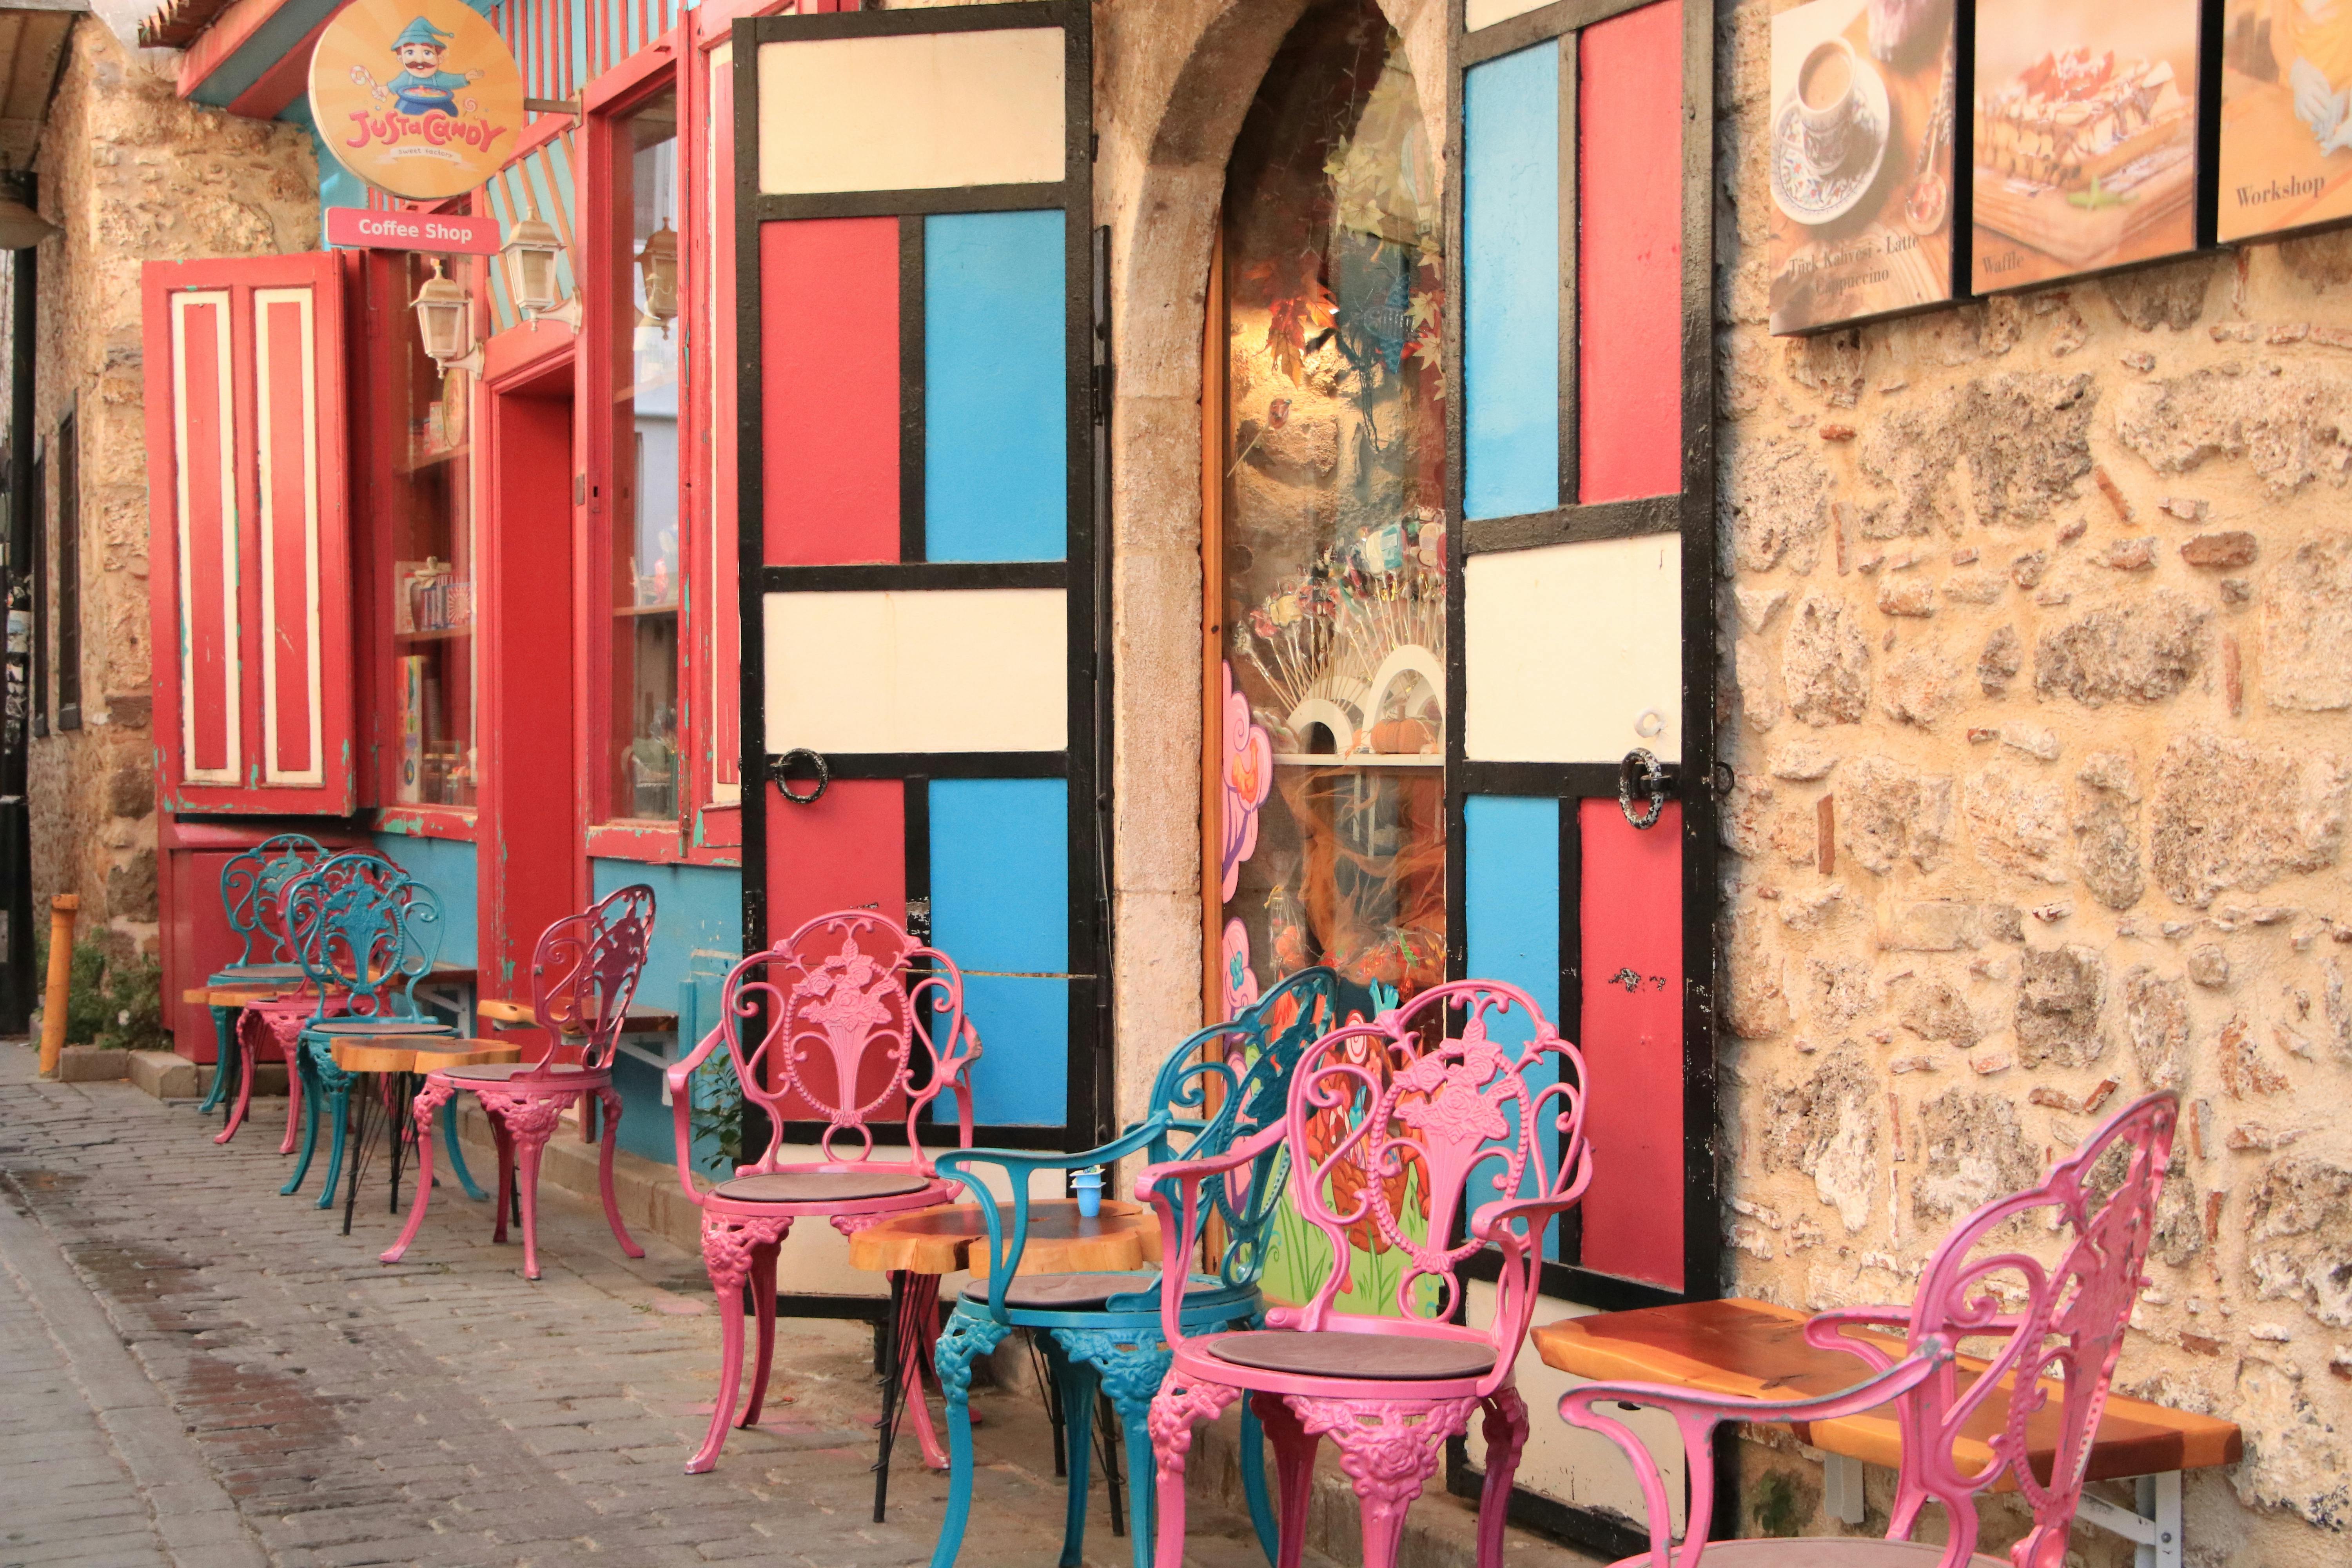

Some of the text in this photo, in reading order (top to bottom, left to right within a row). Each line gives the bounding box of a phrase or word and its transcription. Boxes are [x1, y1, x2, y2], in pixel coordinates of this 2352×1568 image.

[425, 148, 453, 158] factory
[2236, 175, 2325, 208] Workshop
[359, 219, 473, 244] Coffee Shop
[1789, 254, 1818, 276] Türk
[1824, 241, 1873, 269] Kahvesi
[1886, 235, 1919, 255] Latte
[1982, 250, 2024, 274] Waffle
[1815, 267, 1889, 296] Cappuccino
